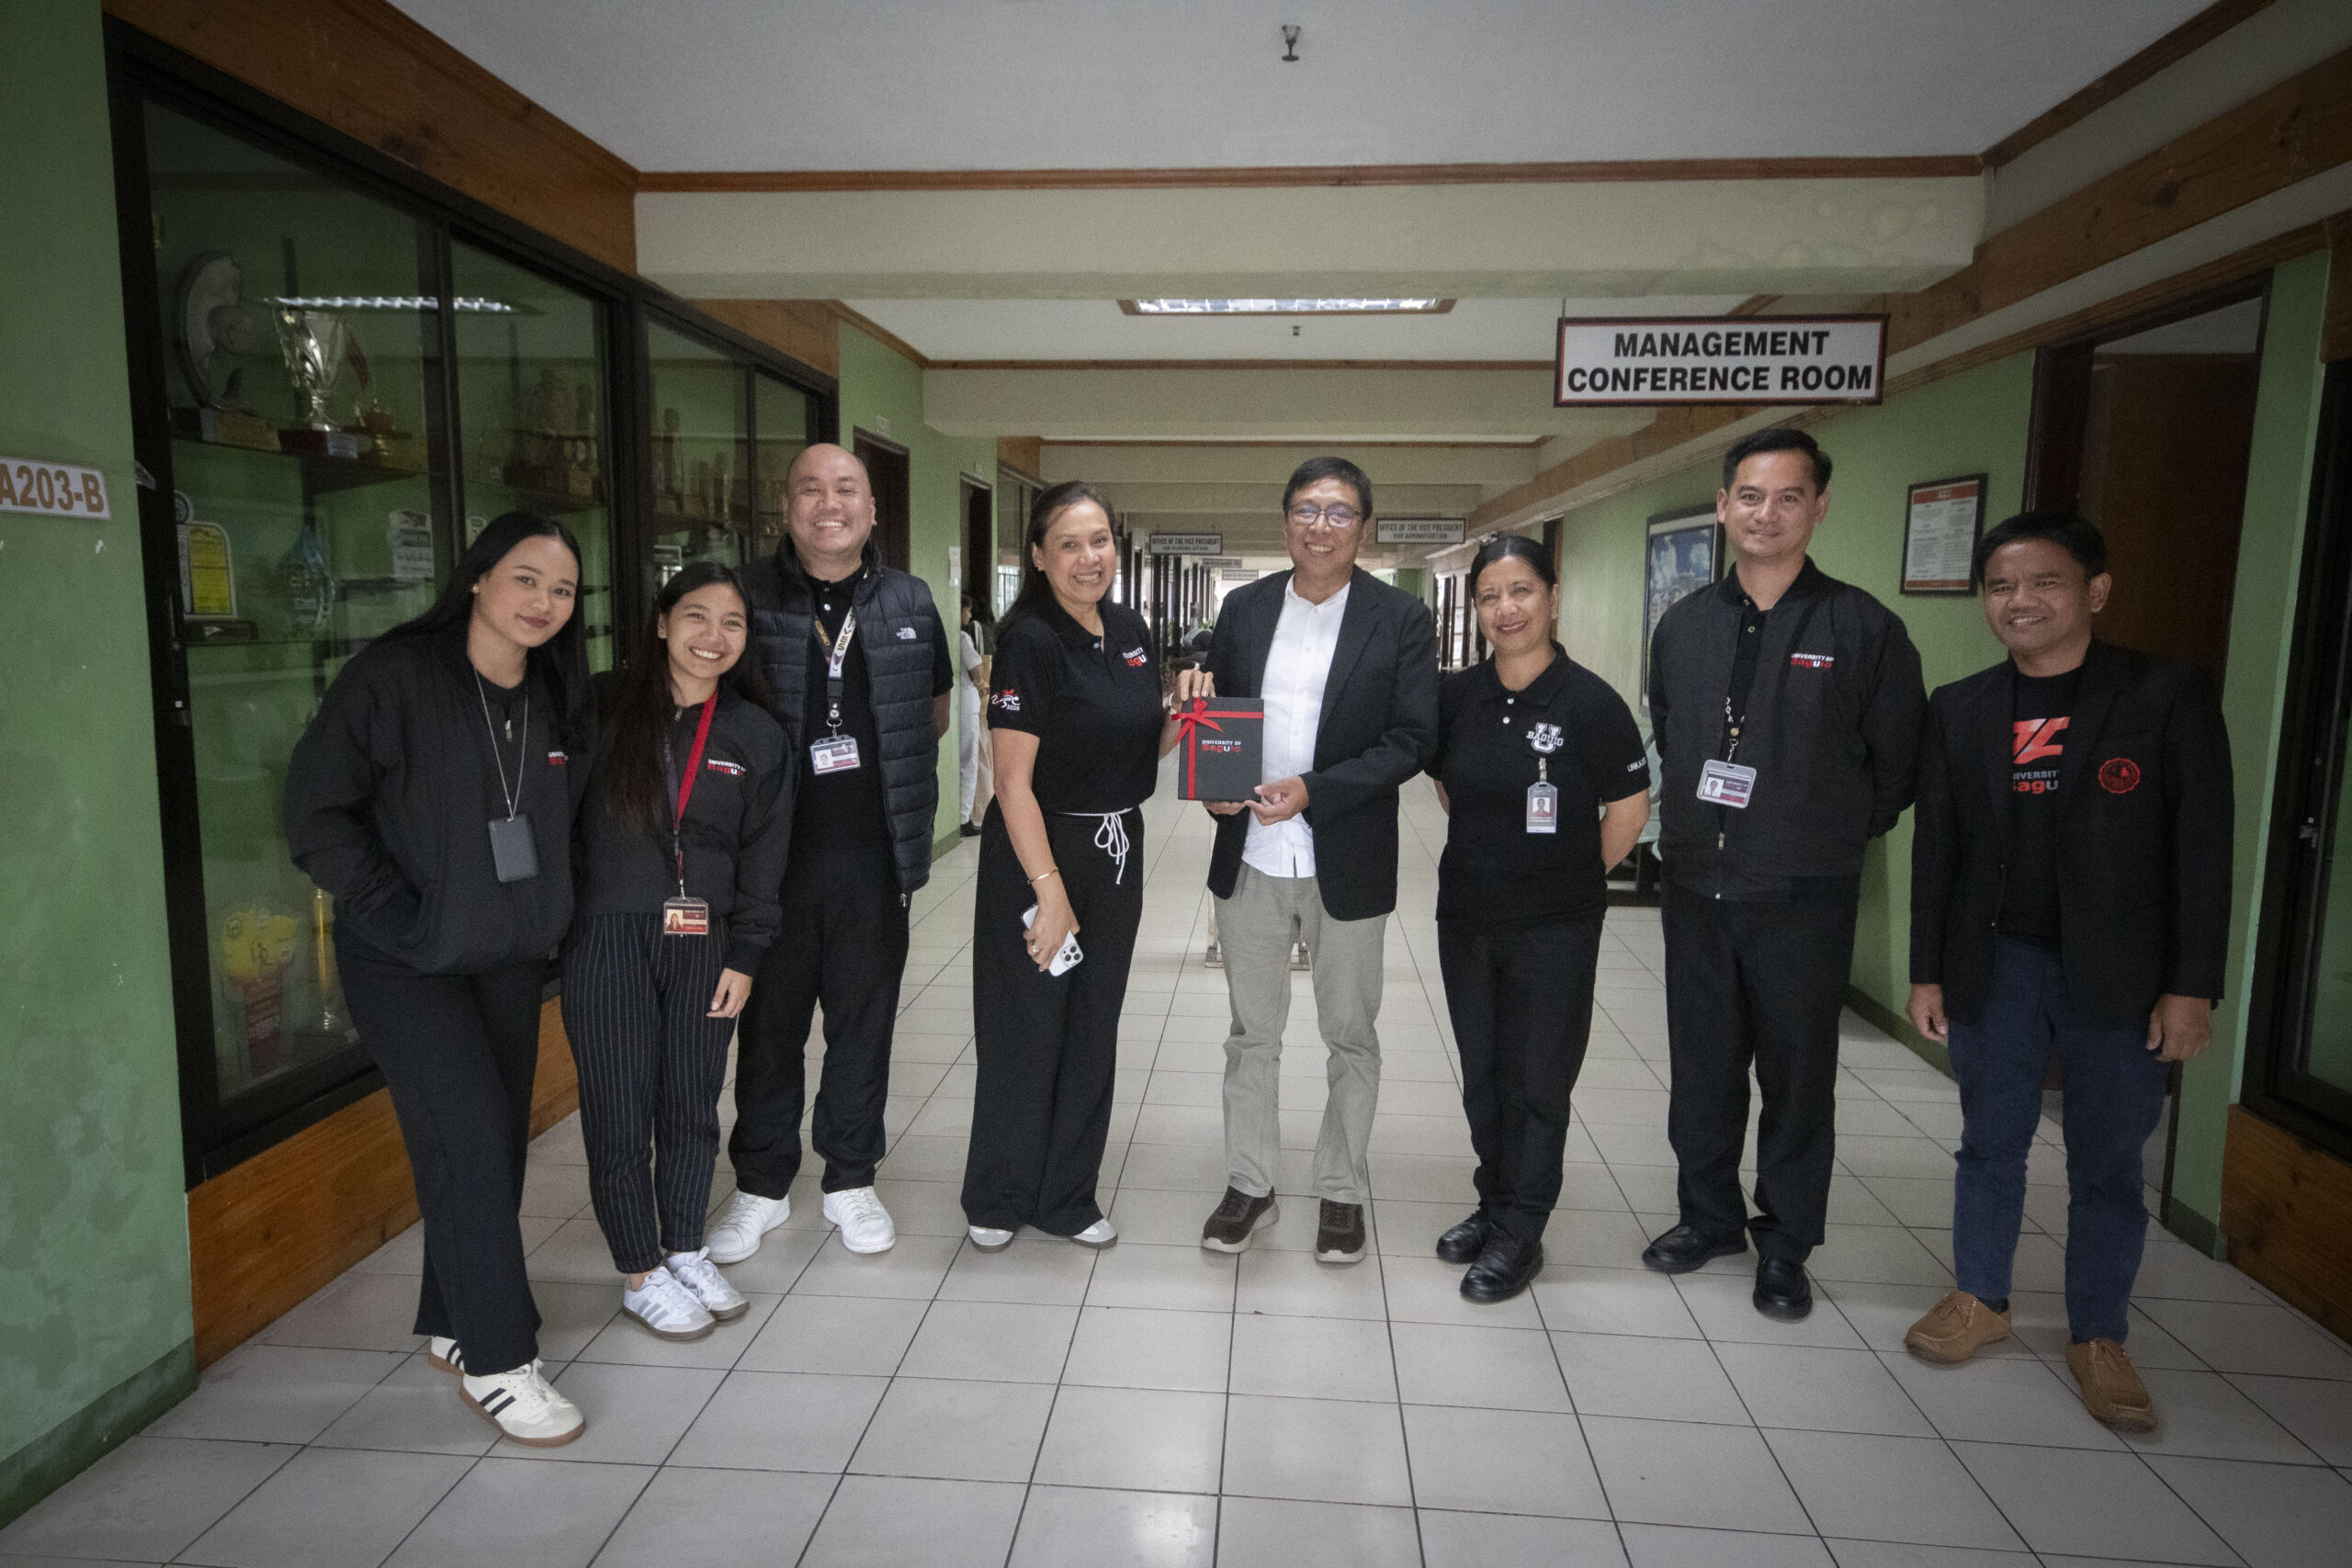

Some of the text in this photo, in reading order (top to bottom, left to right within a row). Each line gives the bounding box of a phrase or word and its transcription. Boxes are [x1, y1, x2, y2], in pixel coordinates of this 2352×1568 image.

[1614, 330, 1830, 357] MANAGEMENT
[1567, 365, 1872, 392] CONFERENCE ROOM
[0, 463, 104, 513] A203-B
